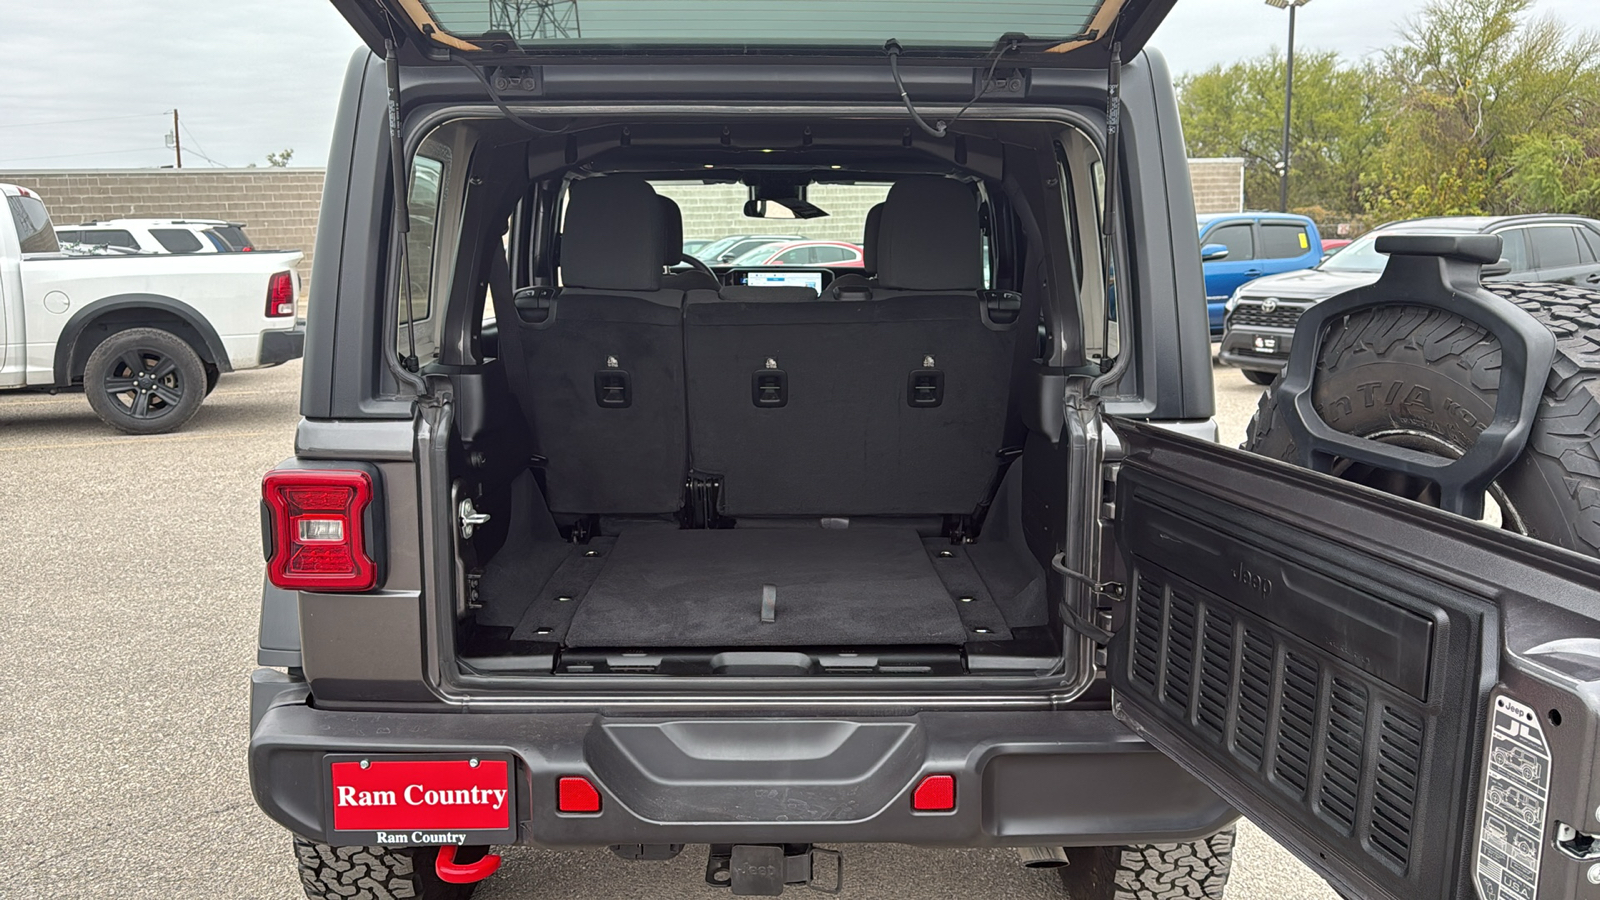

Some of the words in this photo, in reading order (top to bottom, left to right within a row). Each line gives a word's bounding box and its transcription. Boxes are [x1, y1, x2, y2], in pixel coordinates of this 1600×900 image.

[1356, 379, 1434, 413] T/A
[1231, 562, 1272, 599] Jeep
[1505, 703, 1525, 717] Jeep
[1495, 719, 1543, 747] JL
[336, 785, 397, 807] Ram
[403, 784, 508, 810] Country
[376, 831, 409, 844] Ram
[411, 831, 467, 846] Country
[1503, 876, 1531, 900] USA
